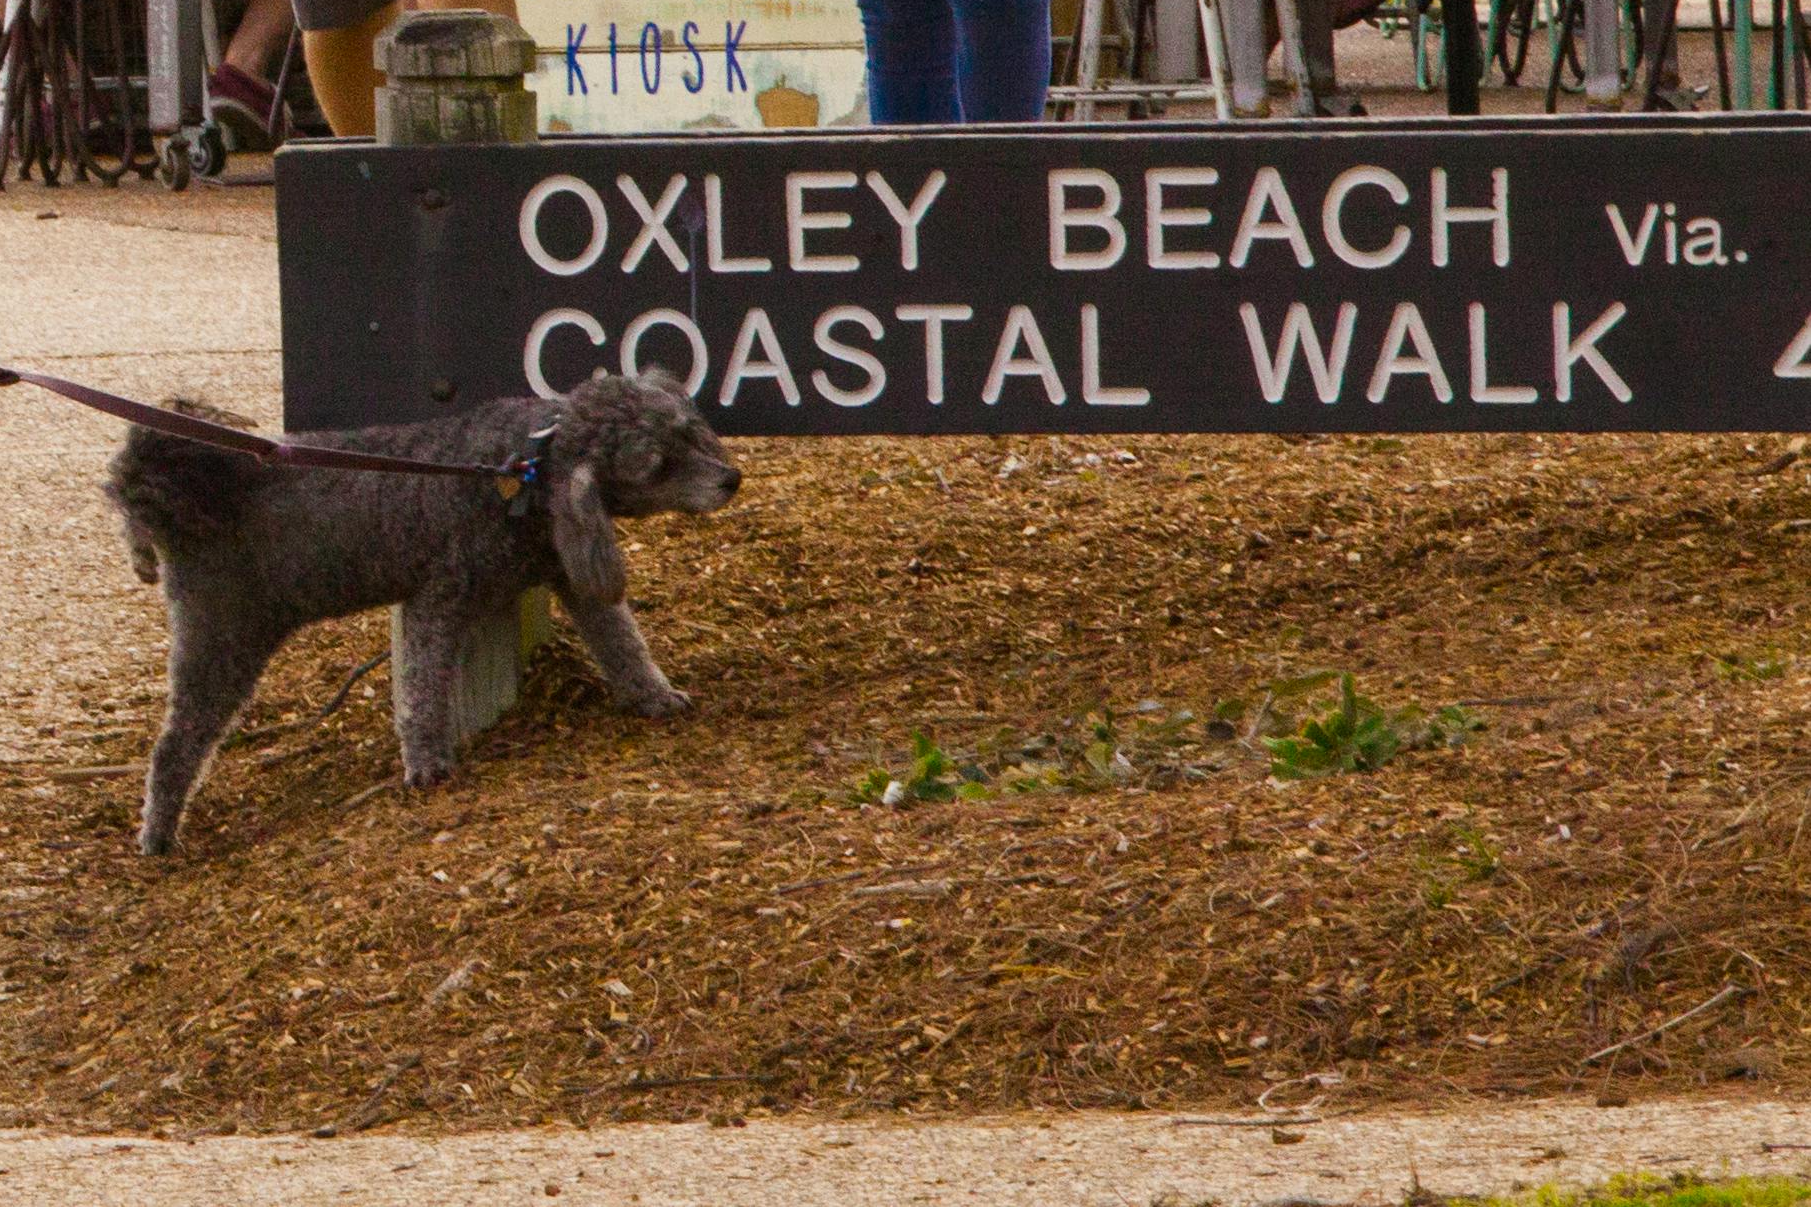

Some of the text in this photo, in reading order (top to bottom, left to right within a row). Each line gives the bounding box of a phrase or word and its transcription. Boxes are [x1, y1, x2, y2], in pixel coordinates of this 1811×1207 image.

[564, 21, 748, 96] KIOSK
[519, 166, 1747, 276] OXLEY BEACH Via.
[524, 302, 1632, 407] COASTAL WALK
